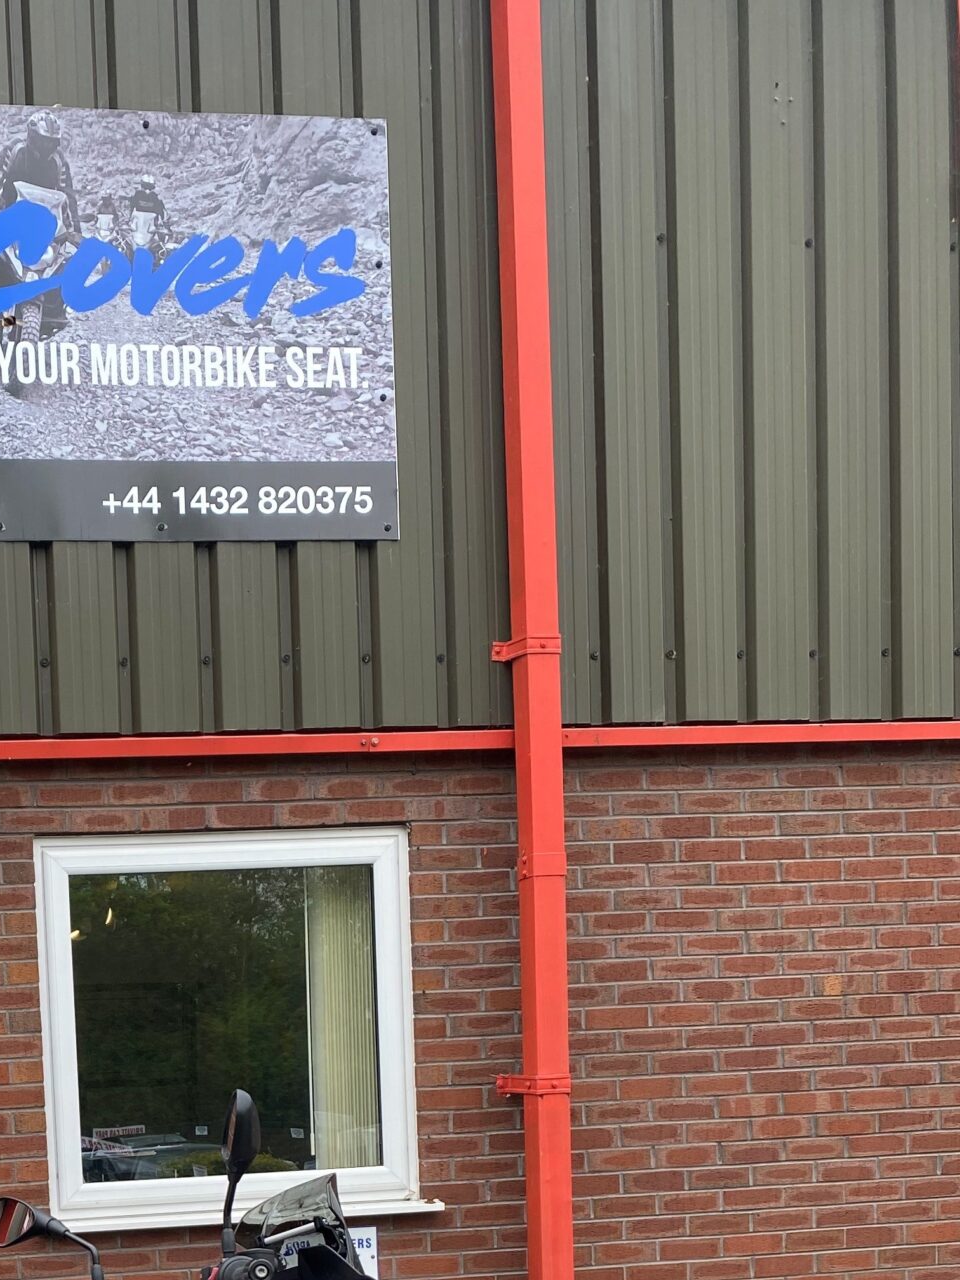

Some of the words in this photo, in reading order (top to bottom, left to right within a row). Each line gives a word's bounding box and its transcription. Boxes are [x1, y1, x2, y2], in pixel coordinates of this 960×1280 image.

[90, 343, 277, 388] MOTORBIKE
[285, 346, 369, 390] SEAT.
[102, 486, 161, 516] +44
[171, 486, 249, 515] 1432
[257, 486, 374, 515] 820375
